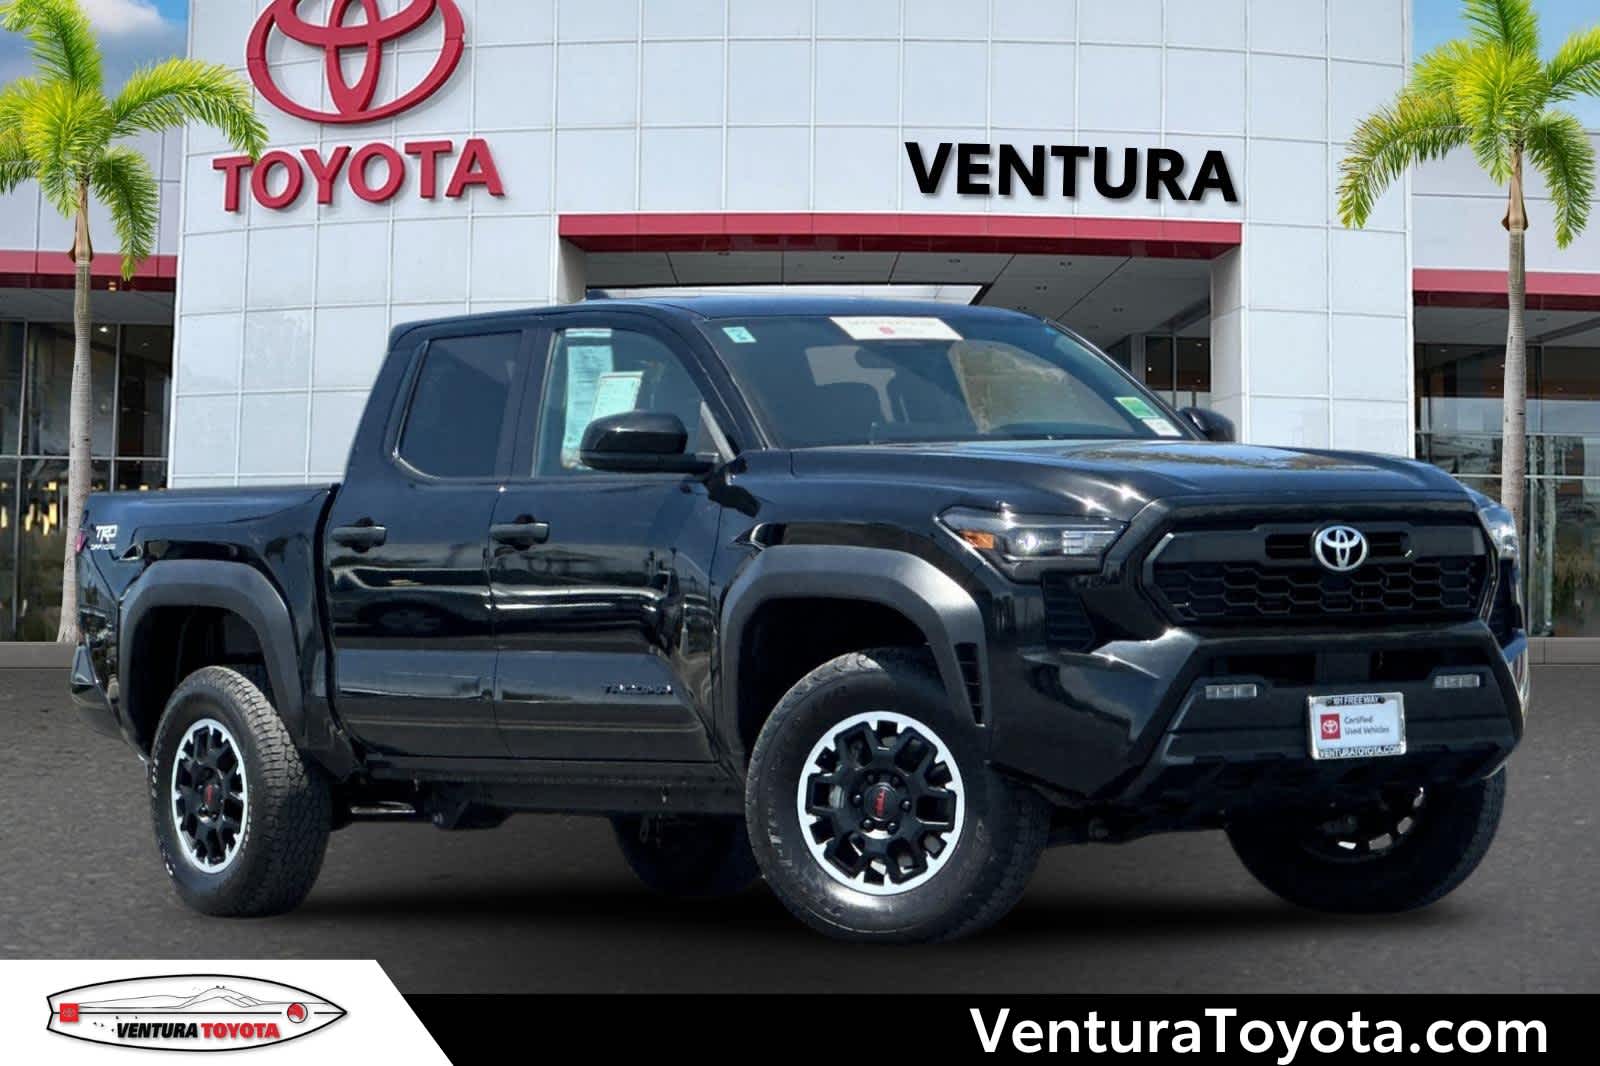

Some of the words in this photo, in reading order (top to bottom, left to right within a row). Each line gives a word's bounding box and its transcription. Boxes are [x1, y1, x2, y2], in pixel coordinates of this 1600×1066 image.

[213, 138, 503, 212] TOYOTA
[905, 142, 1237, 202] VENTURA
[96, 524, 118, 542] TRD
[1344, 694, 1378, 705] FREEWAY
[1344, 715, 1374, 724] Certified
[1345, 726, 1362, 735] Used
[1363, 725, 1390, 735] Vehicles
